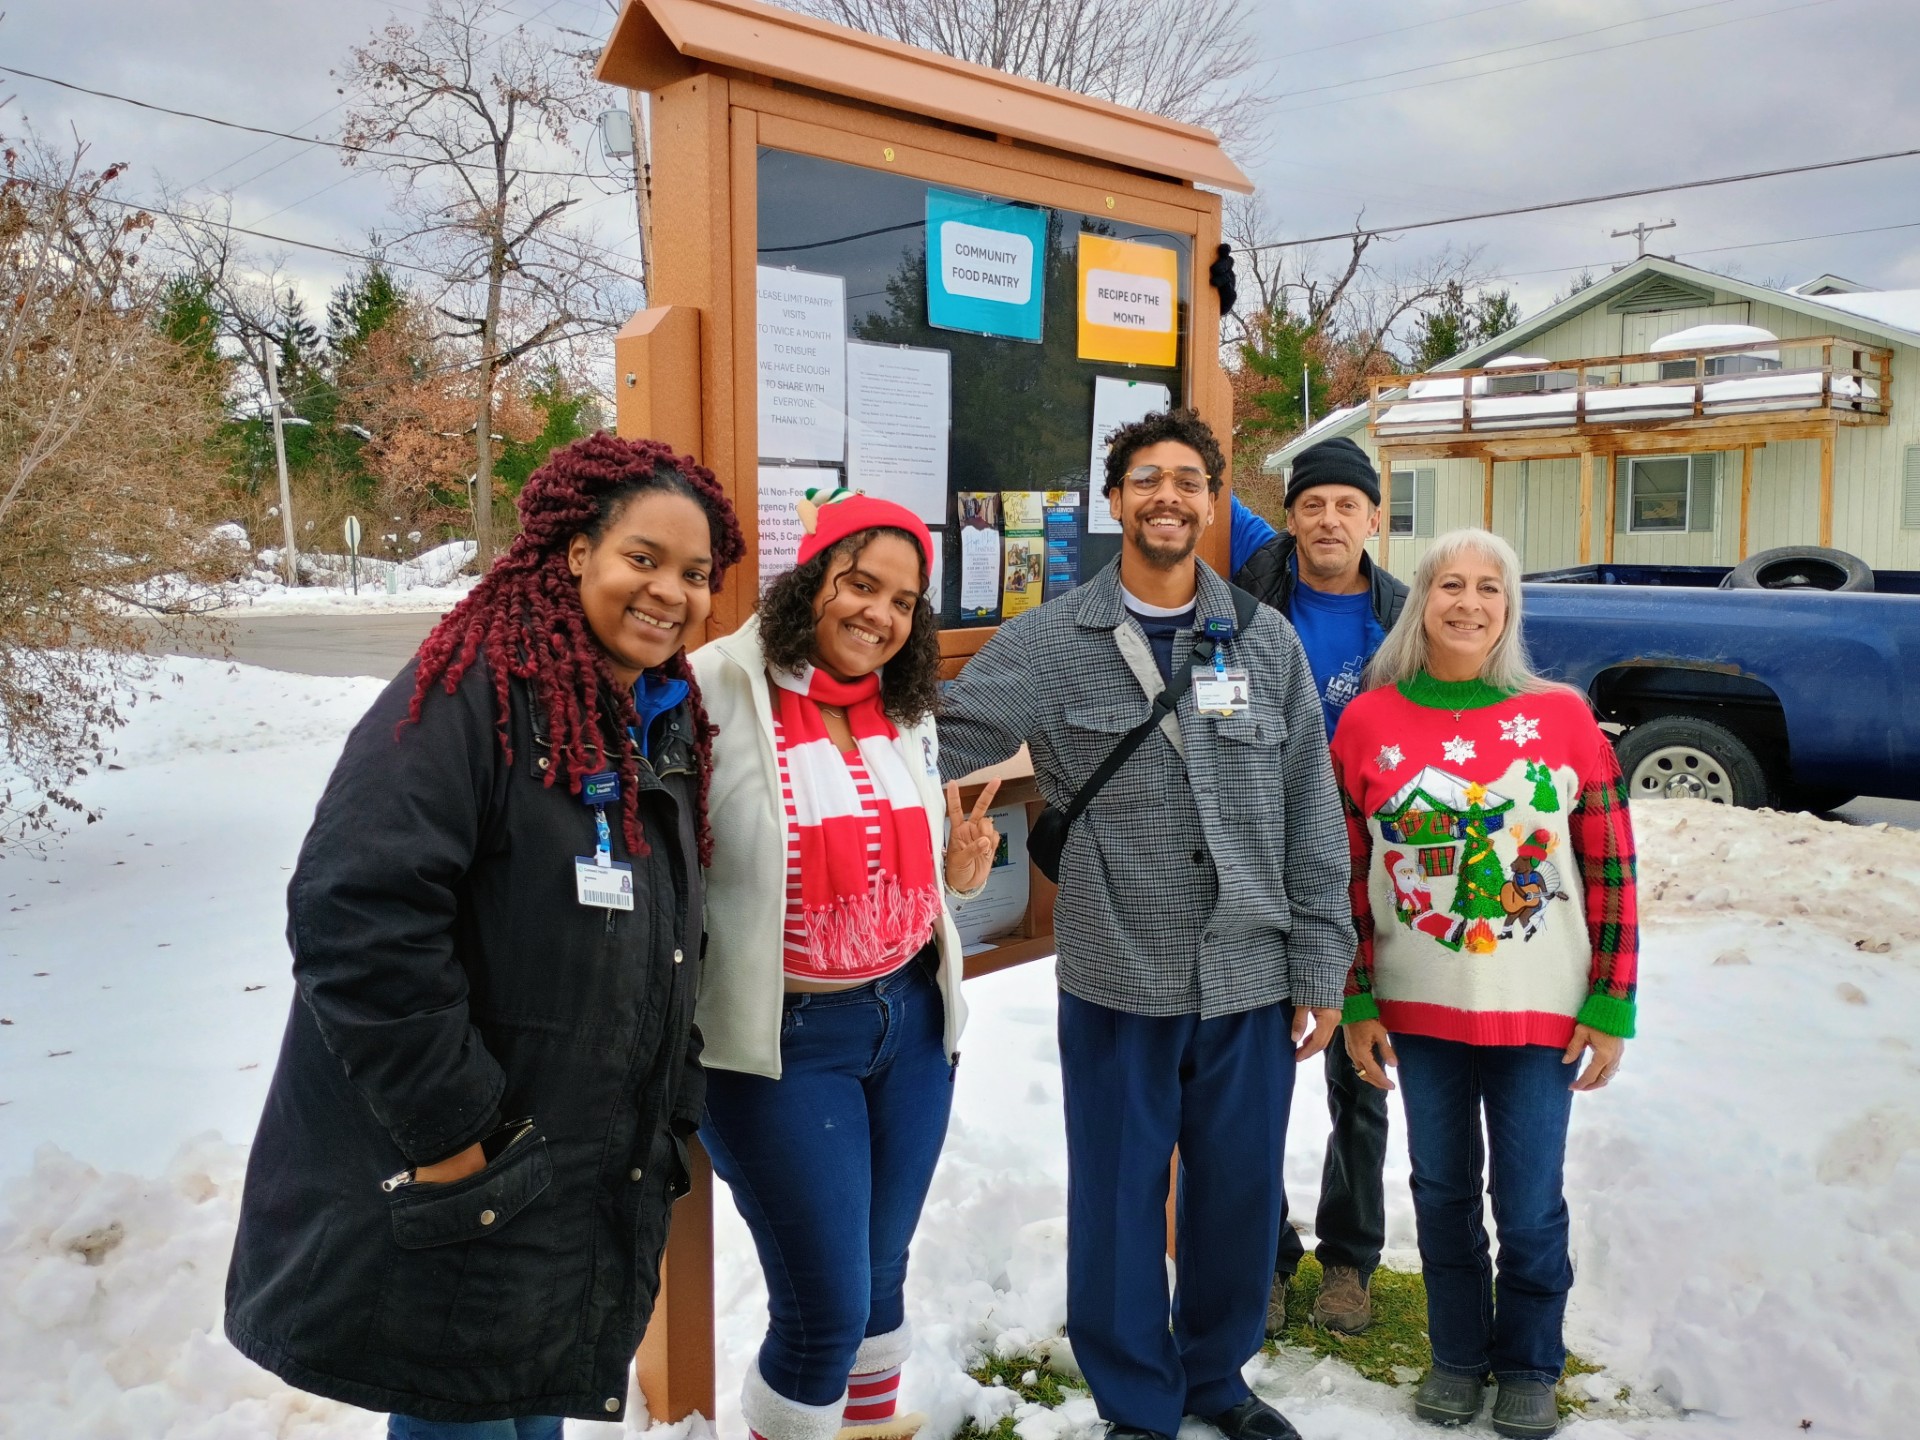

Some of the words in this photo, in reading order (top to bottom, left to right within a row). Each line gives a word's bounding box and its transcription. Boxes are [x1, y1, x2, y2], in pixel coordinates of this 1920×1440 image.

[955, 243, 1017, 265] COMMUNITY
[952, 266, 980, 282] FOOD
[982, 272, 1020, 289] PANTRY
[757, 289, 782, 301] LEASE
[783, 293, 803, 304] LIMIT
[804, 295, 833, 307] PANTRY
[1098, 287, 1129, 302] RECIPE
[1130, 292, 1143, 304] OF
[1144, 294, 1160, 306] THE
[782, 308, 806, 320] VISITS
[1113, 311, 1145, 326] MONTH
[757, 323, 769, 334] TO
[769, 325, 795, 337] TWICE
[796, 328, 802, 337] A
[802, 329, 832, 341] MONTH
[773, 343, 785, 354] TO
[786, 345, 817, 357] ENSURE
[759, 360, 773, 371] WE
[773, 362, 795, 373] HAVE
[796, 364, 831, 376] ENOUGH
[765, 379, 776, 389] TO
[777, 380, 804, 392] SHARE
[804, 383, 825, 393] WITH
[771, 414, 798, 425] THANK
[758, 487, 769, 496] All
[770, 487, 805, 497] Non-Foo
[772, 518, 781, 526] to
[782, 518, 801, 526] start
[780, 532, 785, 540] 5
[758, 548, 772, 556] rue
[773, 547, 796, 556] North
